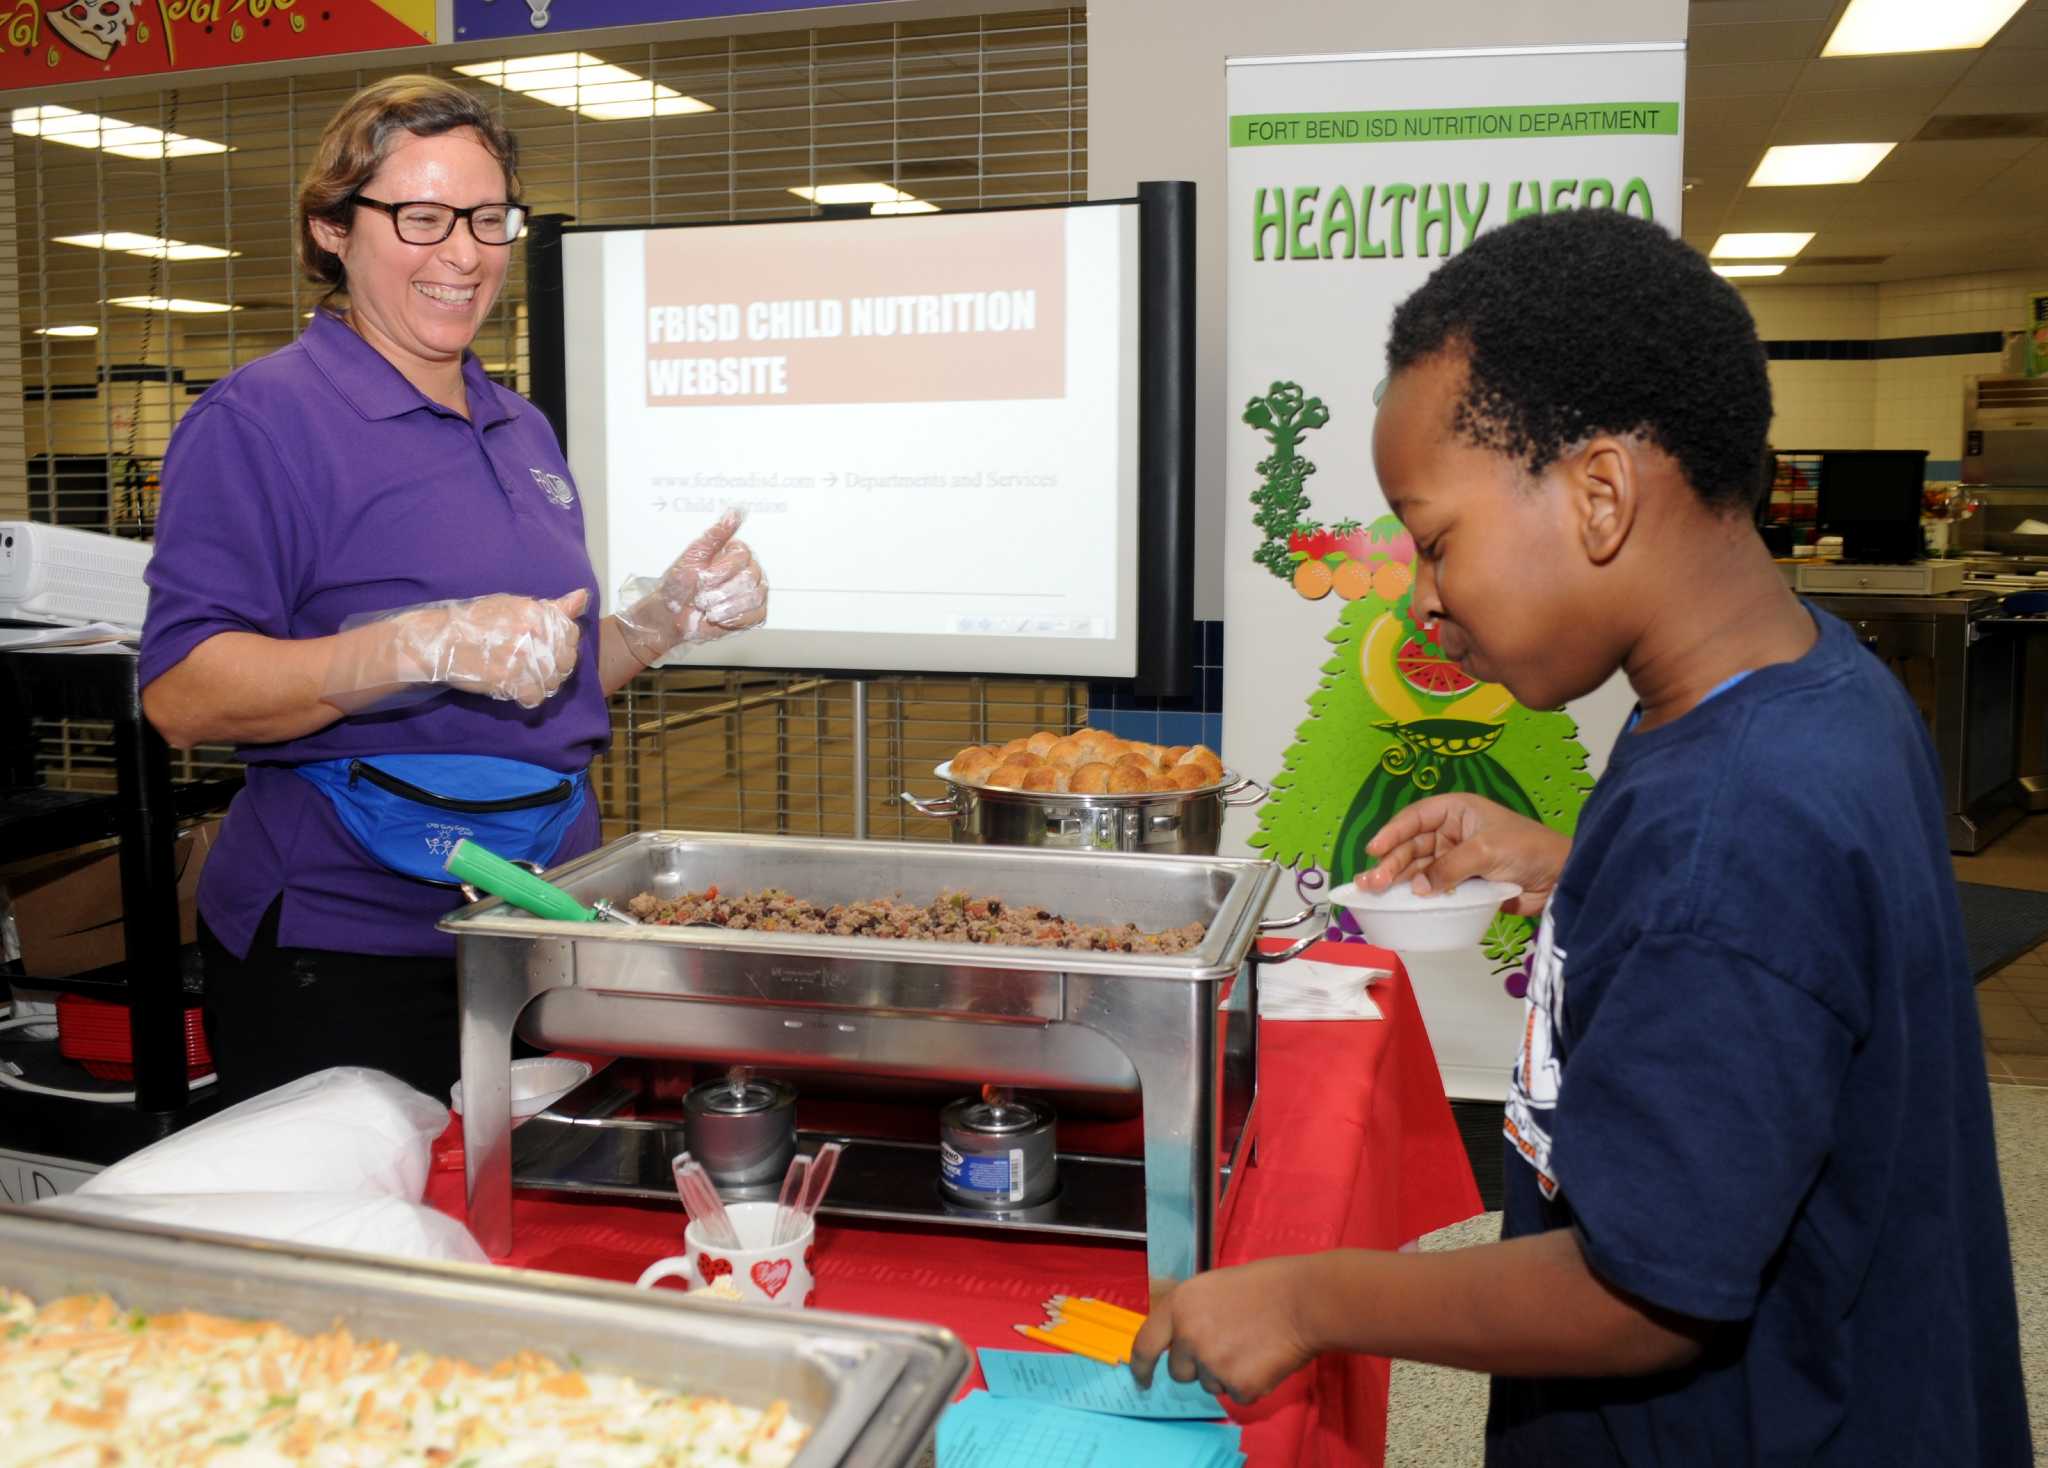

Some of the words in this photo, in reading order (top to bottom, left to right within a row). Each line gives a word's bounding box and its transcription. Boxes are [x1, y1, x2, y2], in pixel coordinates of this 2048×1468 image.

[1247, 120, 1300, 141] FORT
[1305, 119, 1359, 139] BEND
[1366, 118, 1398, 138] ISD
[1404, 114, 1512, 137] NUTRITION
[1519, 110, 1661, 134] DEPARTMENT
[1253, 181, 1489, 261] HEALTHY
[648, 303, 740, 343] FBISD
[747, 298, 843, 341] CHILD
[850, 289, 1037, 337] NUTRITION
[648, 356, 788, 396] WEBSITE
[650, 472, 815, 489] www.fortbendisd.com
[845, 472, 946, 493] Departments
[949, 472, 983, 489] and
[986, 472, 1058, 489] Services
[672, 496, 715, 513] Child
